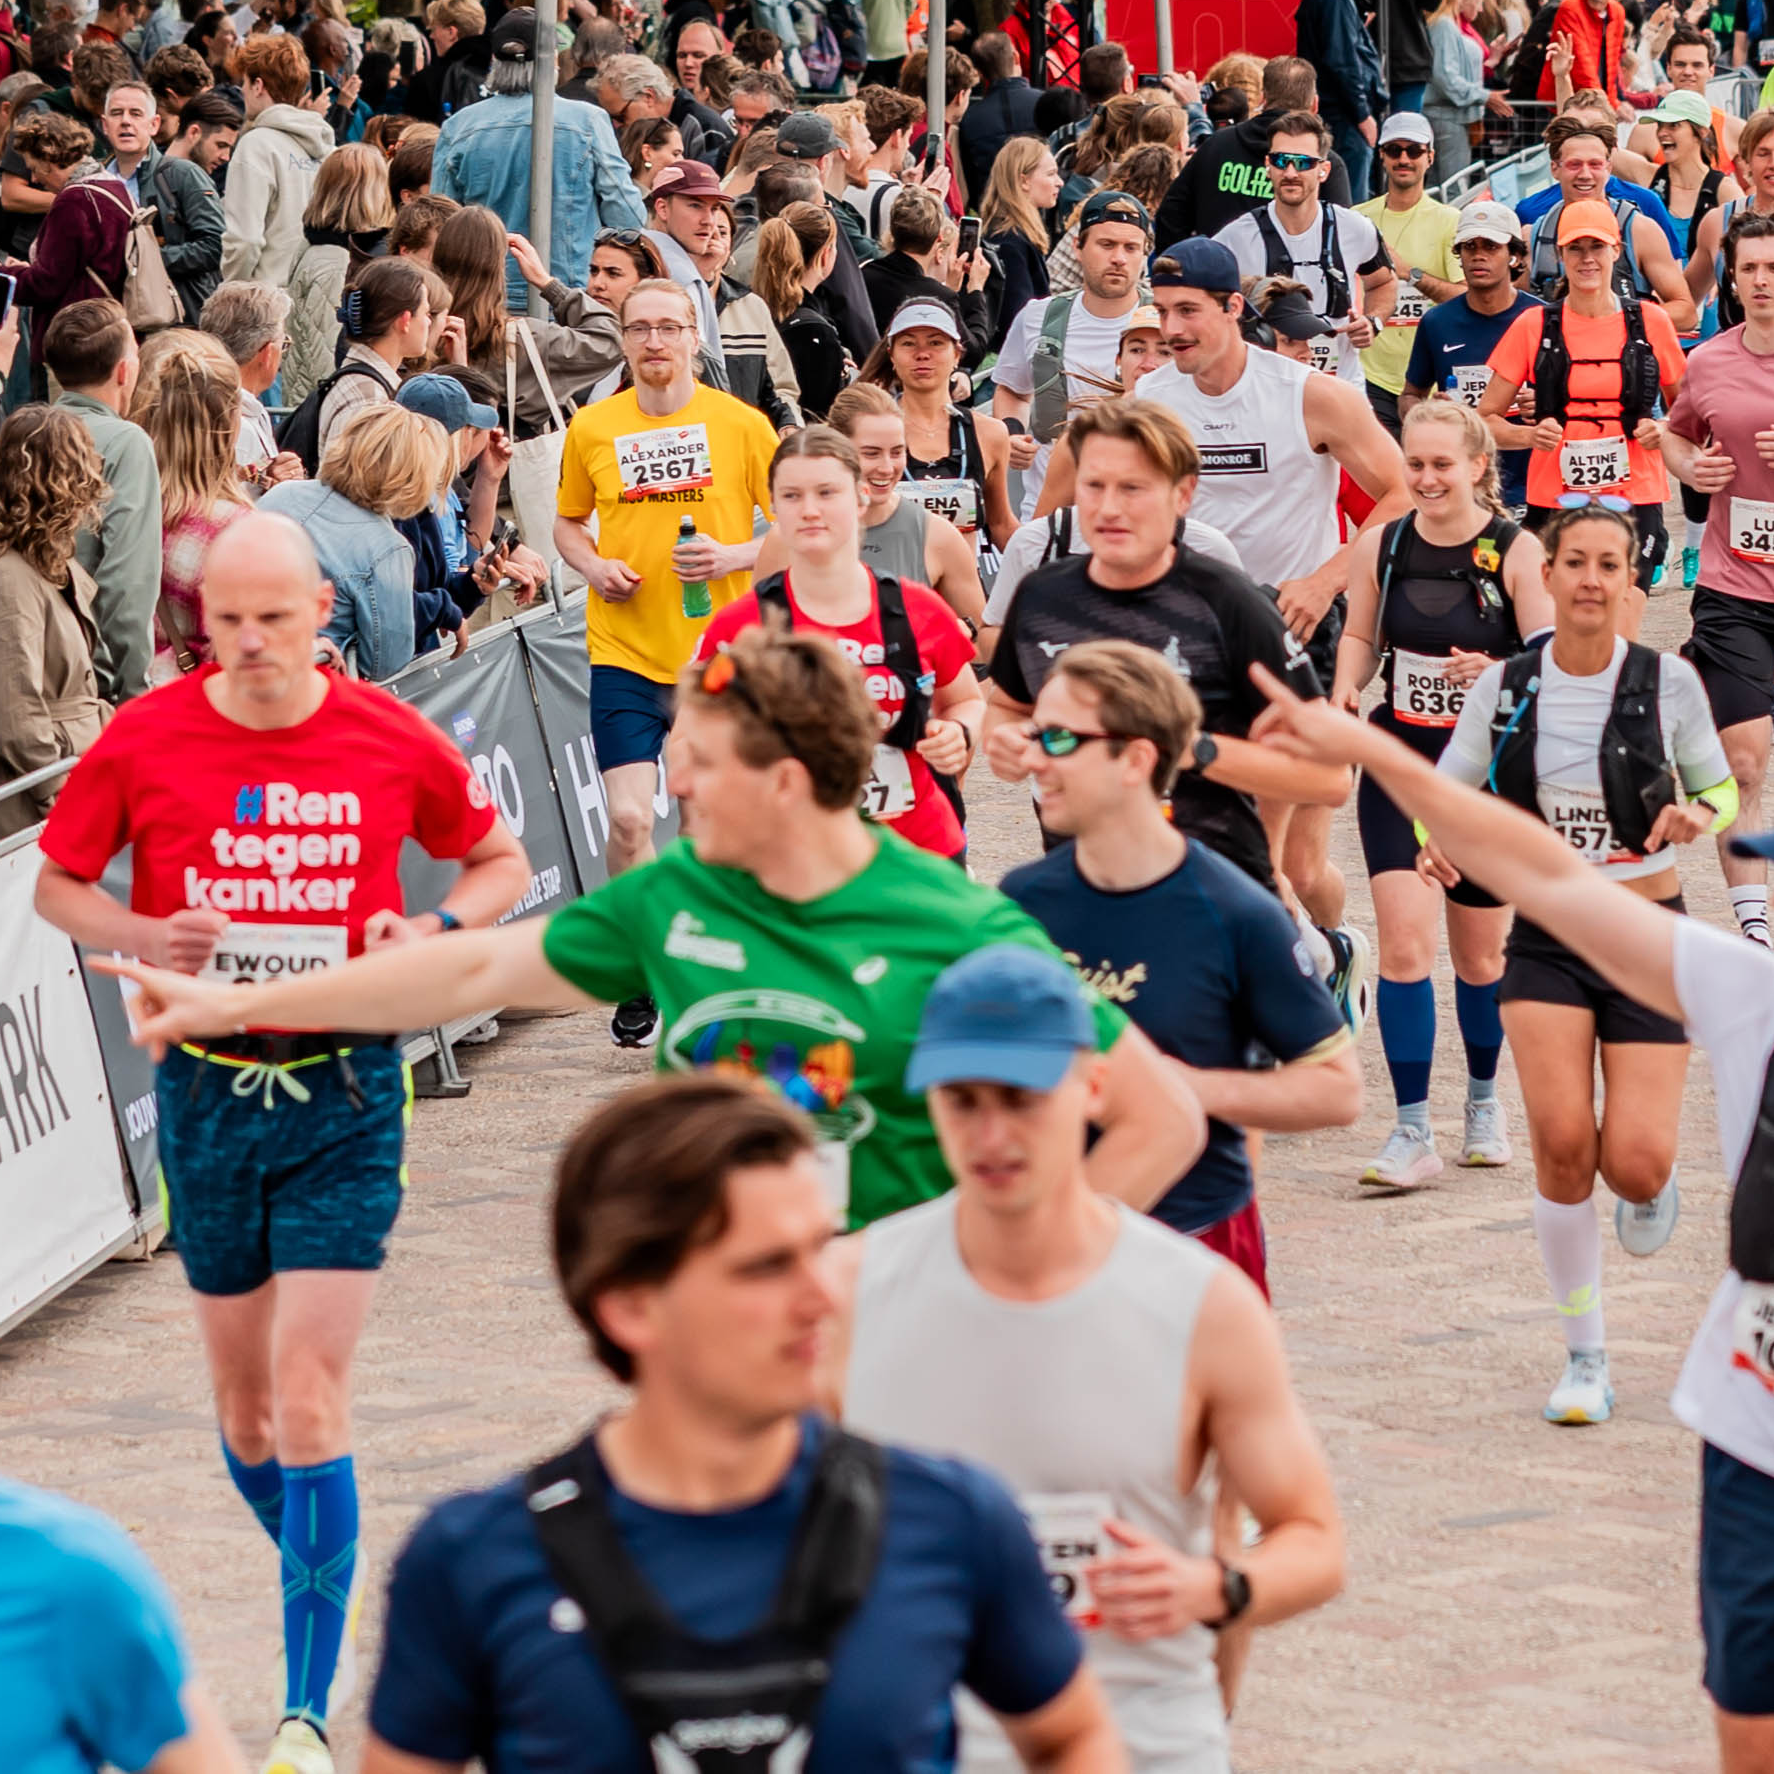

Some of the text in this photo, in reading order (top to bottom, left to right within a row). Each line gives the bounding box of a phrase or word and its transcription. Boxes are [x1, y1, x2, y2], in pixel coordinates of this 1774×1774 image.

[620, 442, 706, 466] ALEXANDER
[1200, 453, 1252, 466] MONROE
[1569, 452, 1618, 471] ALTINE
[633, 458, 696, 486] 2567
[1571, 462, 1617, 486] 234
[1409, 691, 1466, 715] 636
[234, 781, 362, 826] #Ren
[211, 828, 362, 876] tegen
[184, 866, 356, 913] kanker
[215, 951, 328, 974] EWOUD
